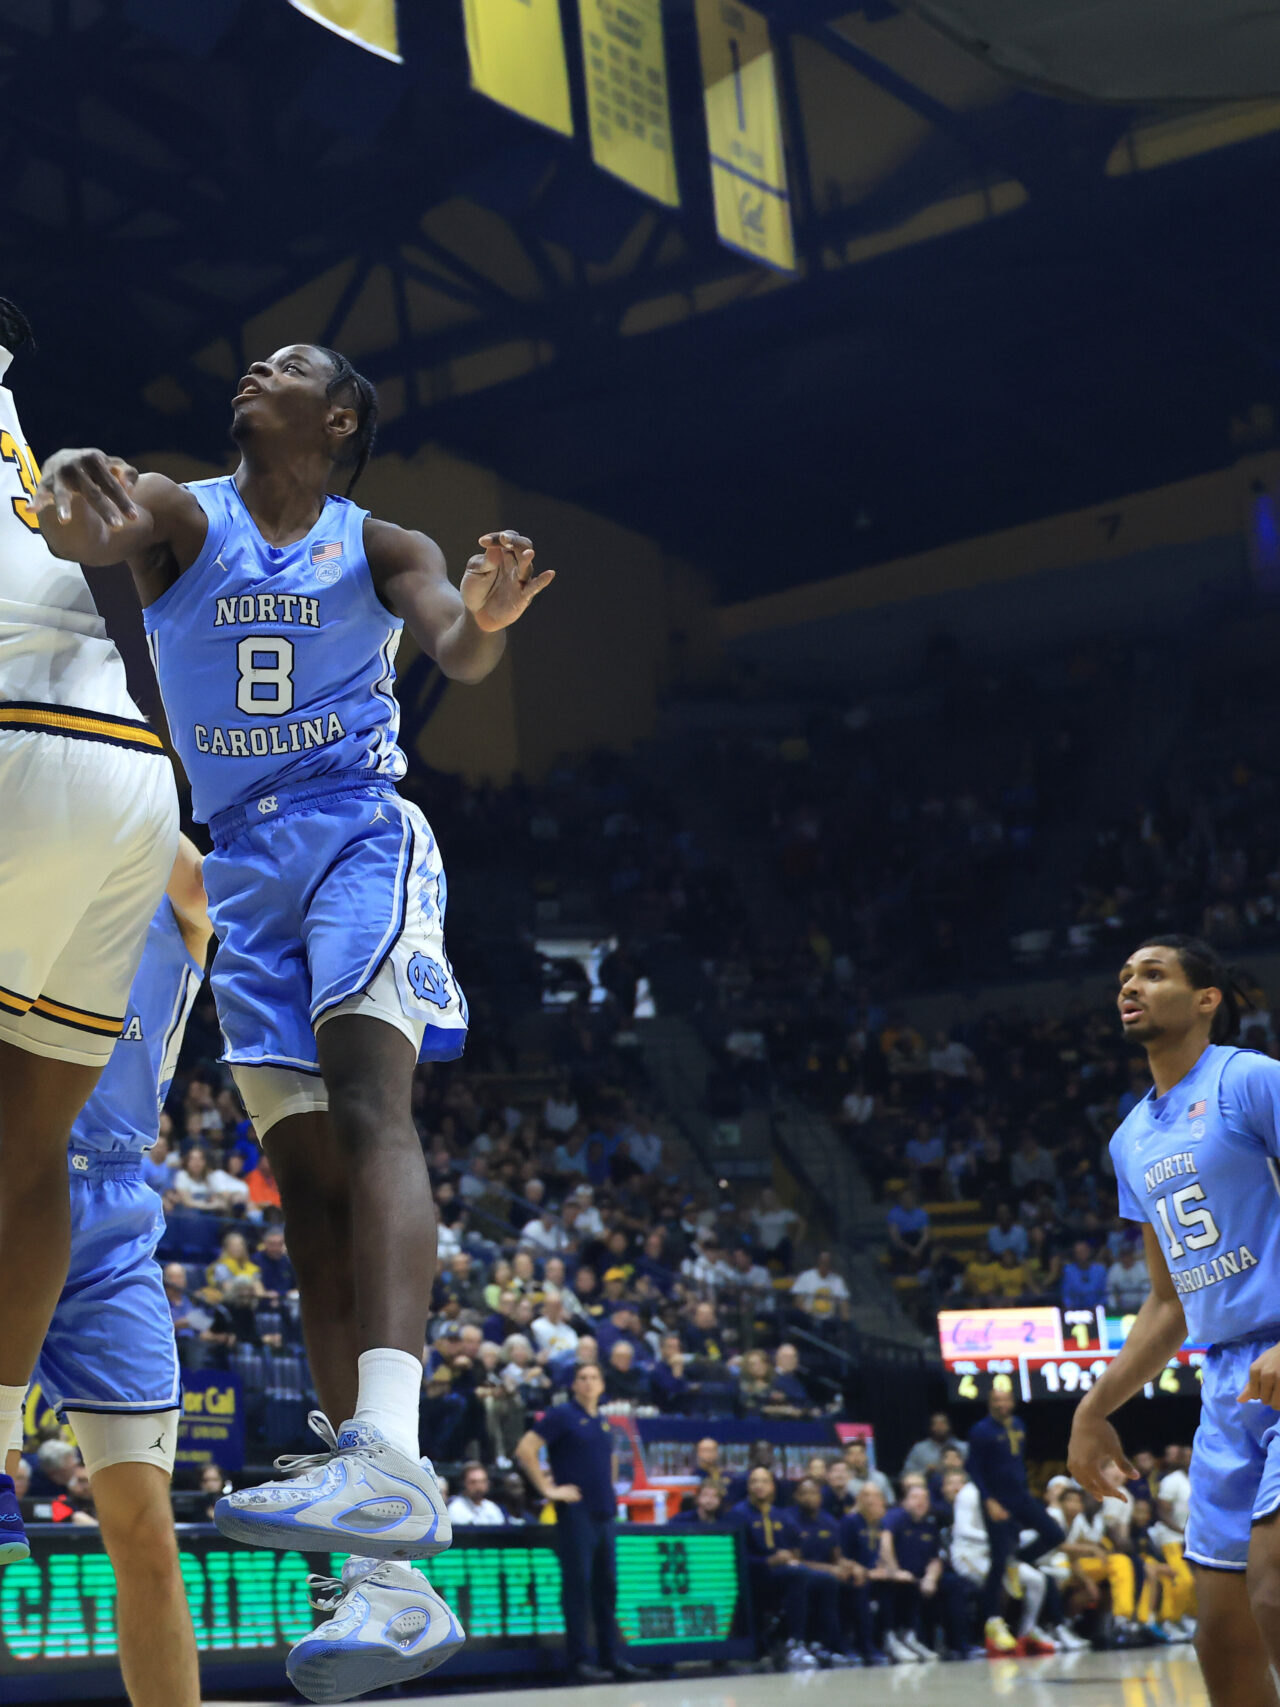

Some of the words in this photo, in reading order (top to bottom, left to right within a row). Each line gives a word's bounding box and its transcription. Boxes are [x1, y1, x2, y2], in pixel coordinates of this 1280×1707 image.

[214, 593, 321, 628] NORTH
[236, 635, 295, 716] 8
[194, 711, 347, 757] CAROLINA
[1144, 1151, 1198, 1194] NORTH
[1155, 1182, 1221, 1260] 15
[1170, 1245, 1259, 1294] CAROLINA
[1071, 1323, 1089, 1350] 1
